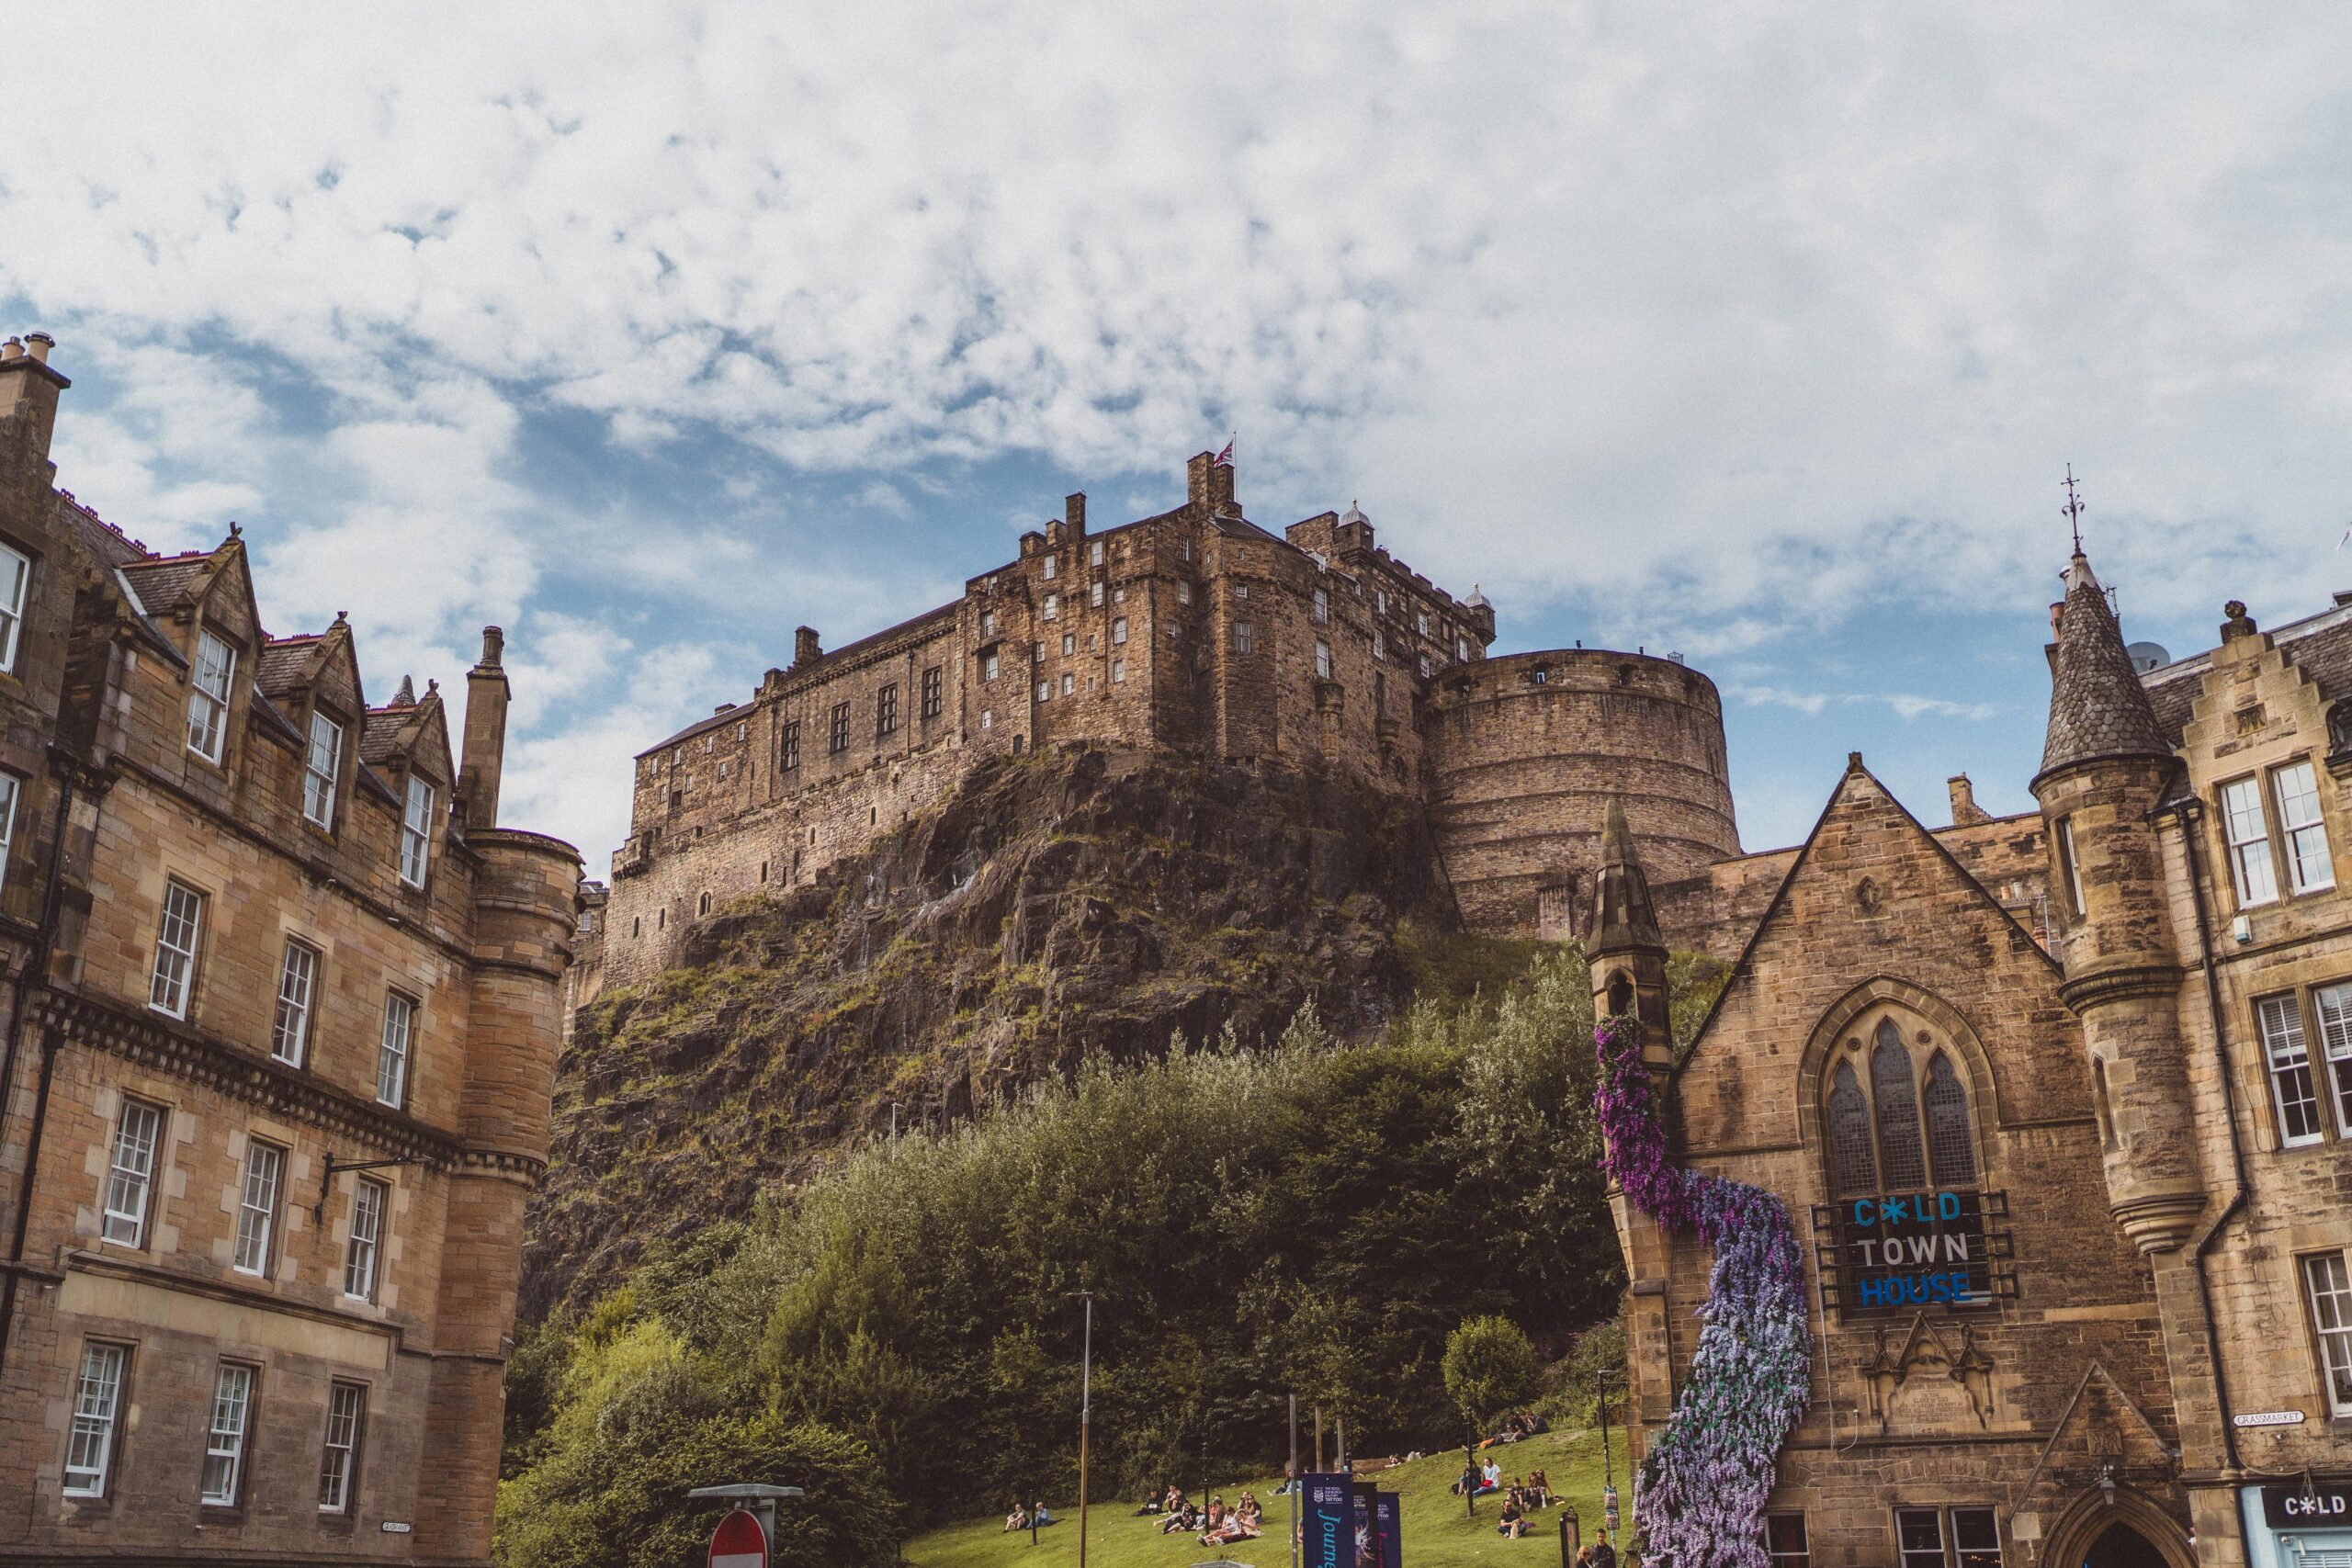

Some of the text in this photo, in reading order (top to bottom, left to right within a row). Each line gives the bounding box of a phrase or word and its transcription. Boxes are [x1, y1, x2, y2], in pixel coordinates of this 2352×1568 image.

[1857, 1233, 1969, 1267] TOWN
[1860, 1273, 1973, 1308] HOUSE
[2237, 1413, 2300, 1425] GRASSMARKET
